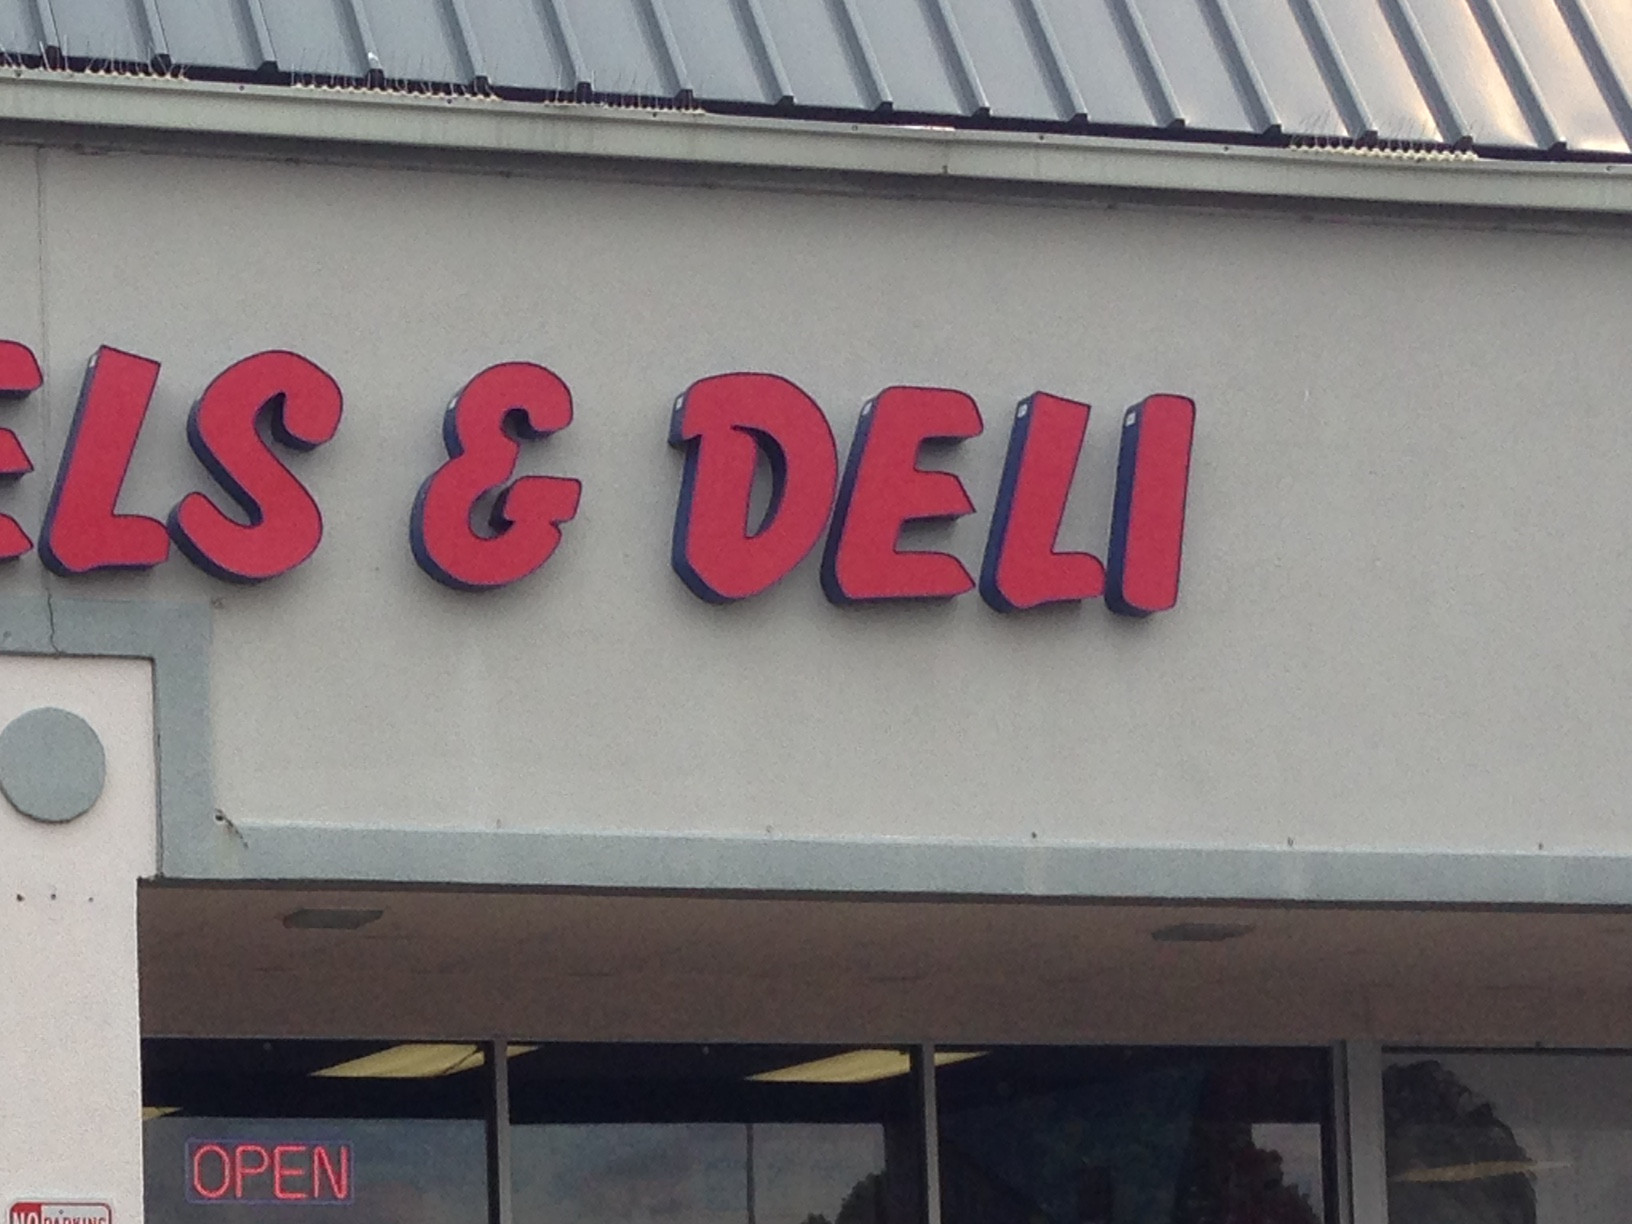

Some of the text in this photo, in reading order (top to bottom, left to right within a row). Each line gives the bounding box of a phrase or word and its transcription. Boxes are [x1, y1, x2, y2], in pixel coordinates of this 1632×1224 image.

[411, 361, 582, 590] &
[668, 371, 1196, 616] DELI
[191, 1144, 350, 1199] OPEN
